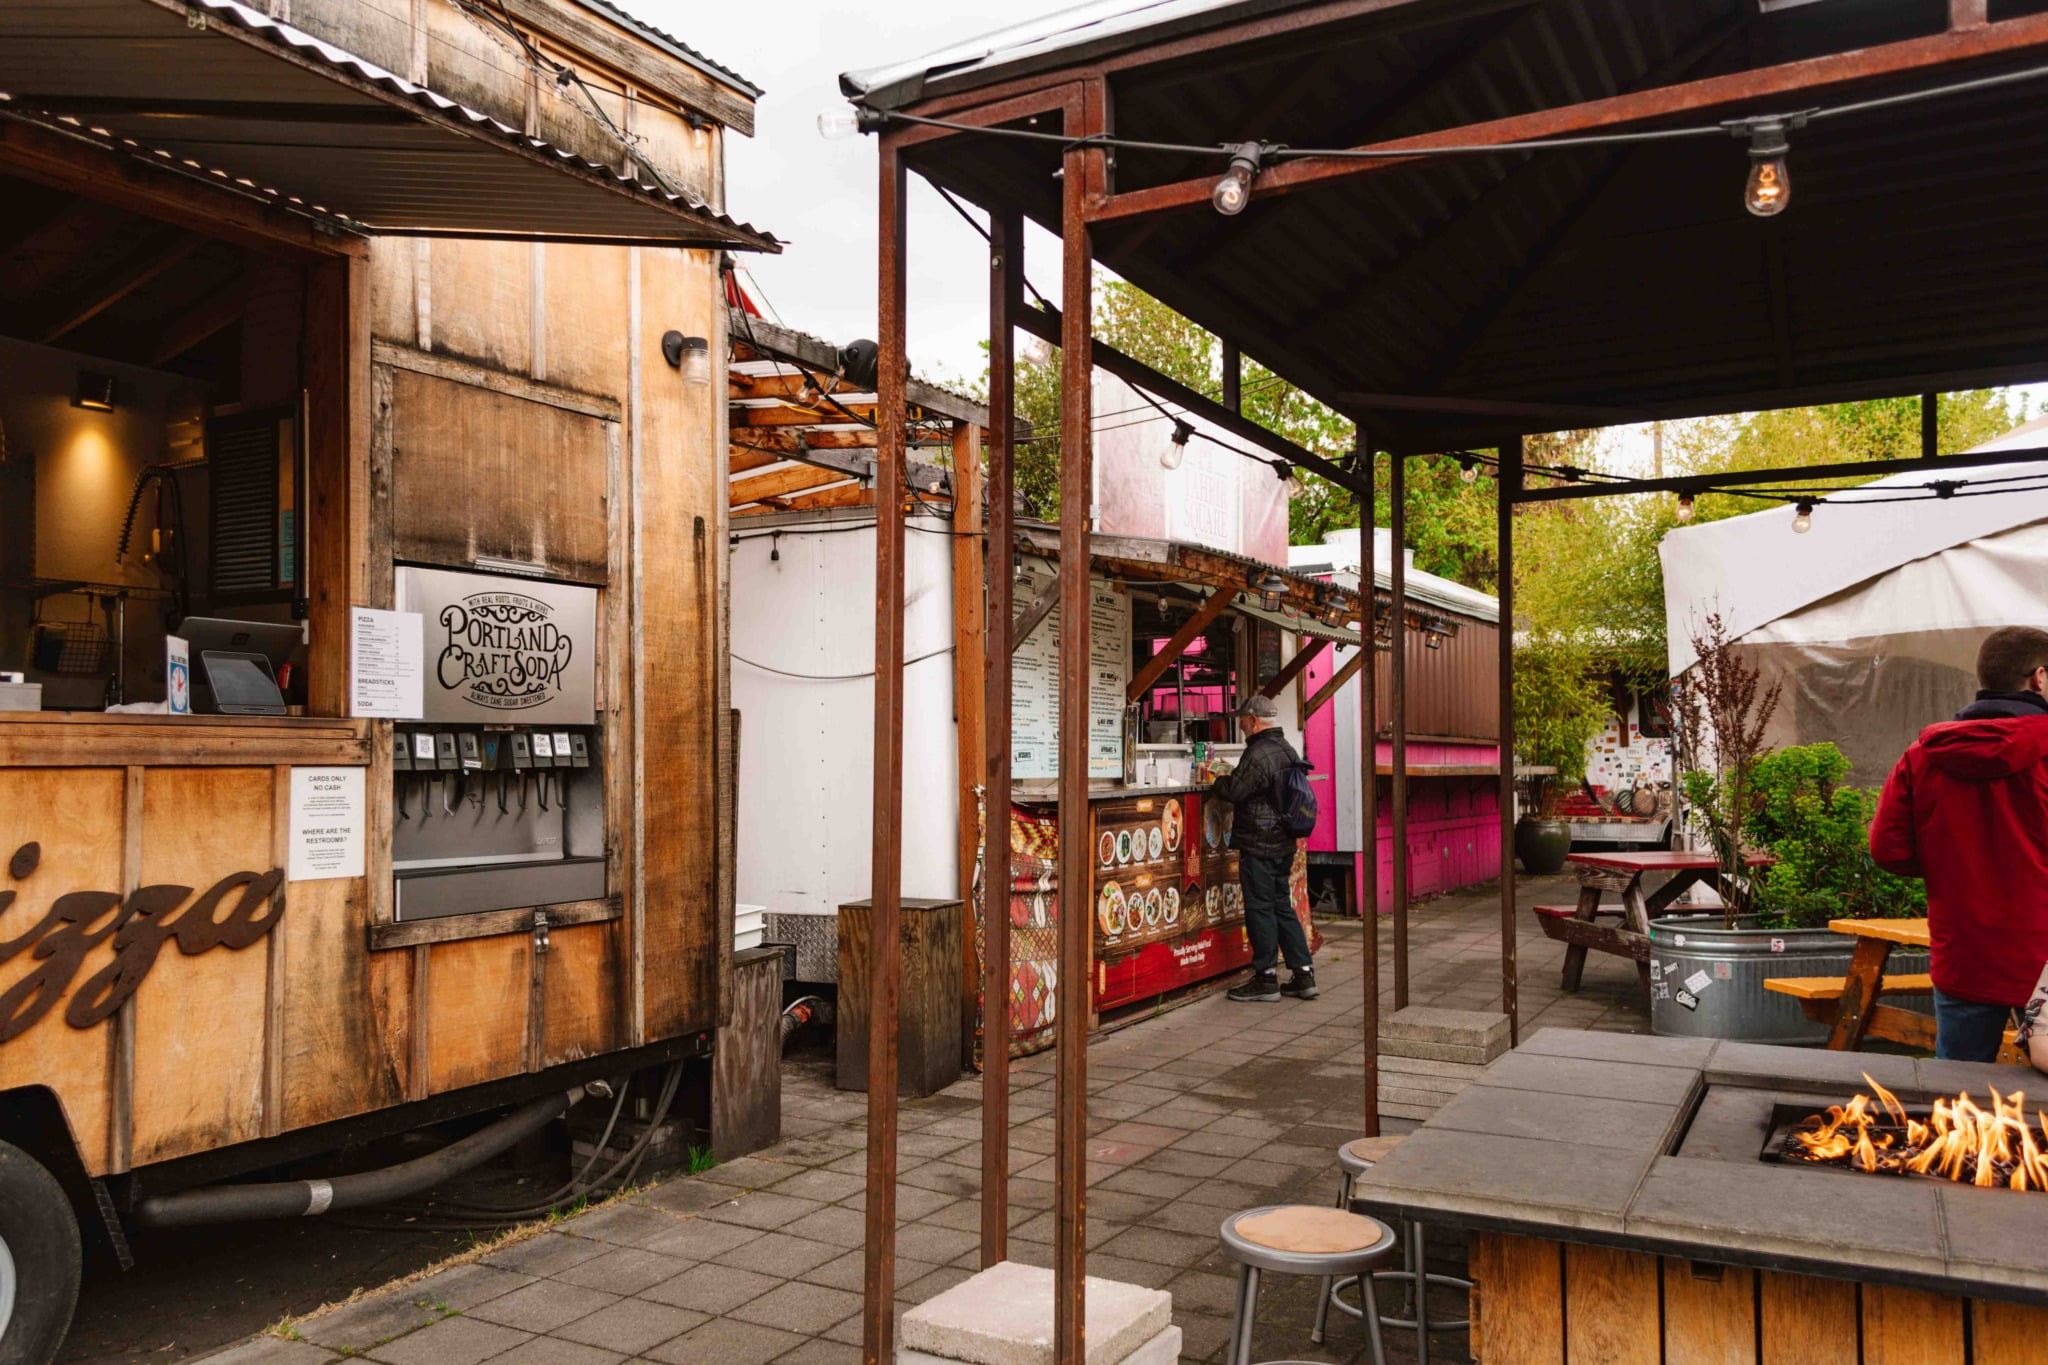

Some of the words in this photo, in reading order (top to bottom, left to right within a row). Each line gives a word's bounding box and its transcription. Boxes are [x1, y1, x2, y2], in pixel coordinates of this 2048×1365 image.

[1184, 504, 1228, 538] SQUARE
[468, 596, 481, 607] WITH
[482, 595, 494, 604] REAL
[512, 596, 528, 606] FRUITS
[535, 602, 548, 615] HERBS
[440, 605, 560, 658] PORTLAND
[437, 644, 511, 690] CRAFT
[510, 635, 572, 692] SODA
[470, 692, 489, 704] ALWAYS
[504, 698, 518, 706] SUGAR
[520, 692, 546, 705] SWEETENED
